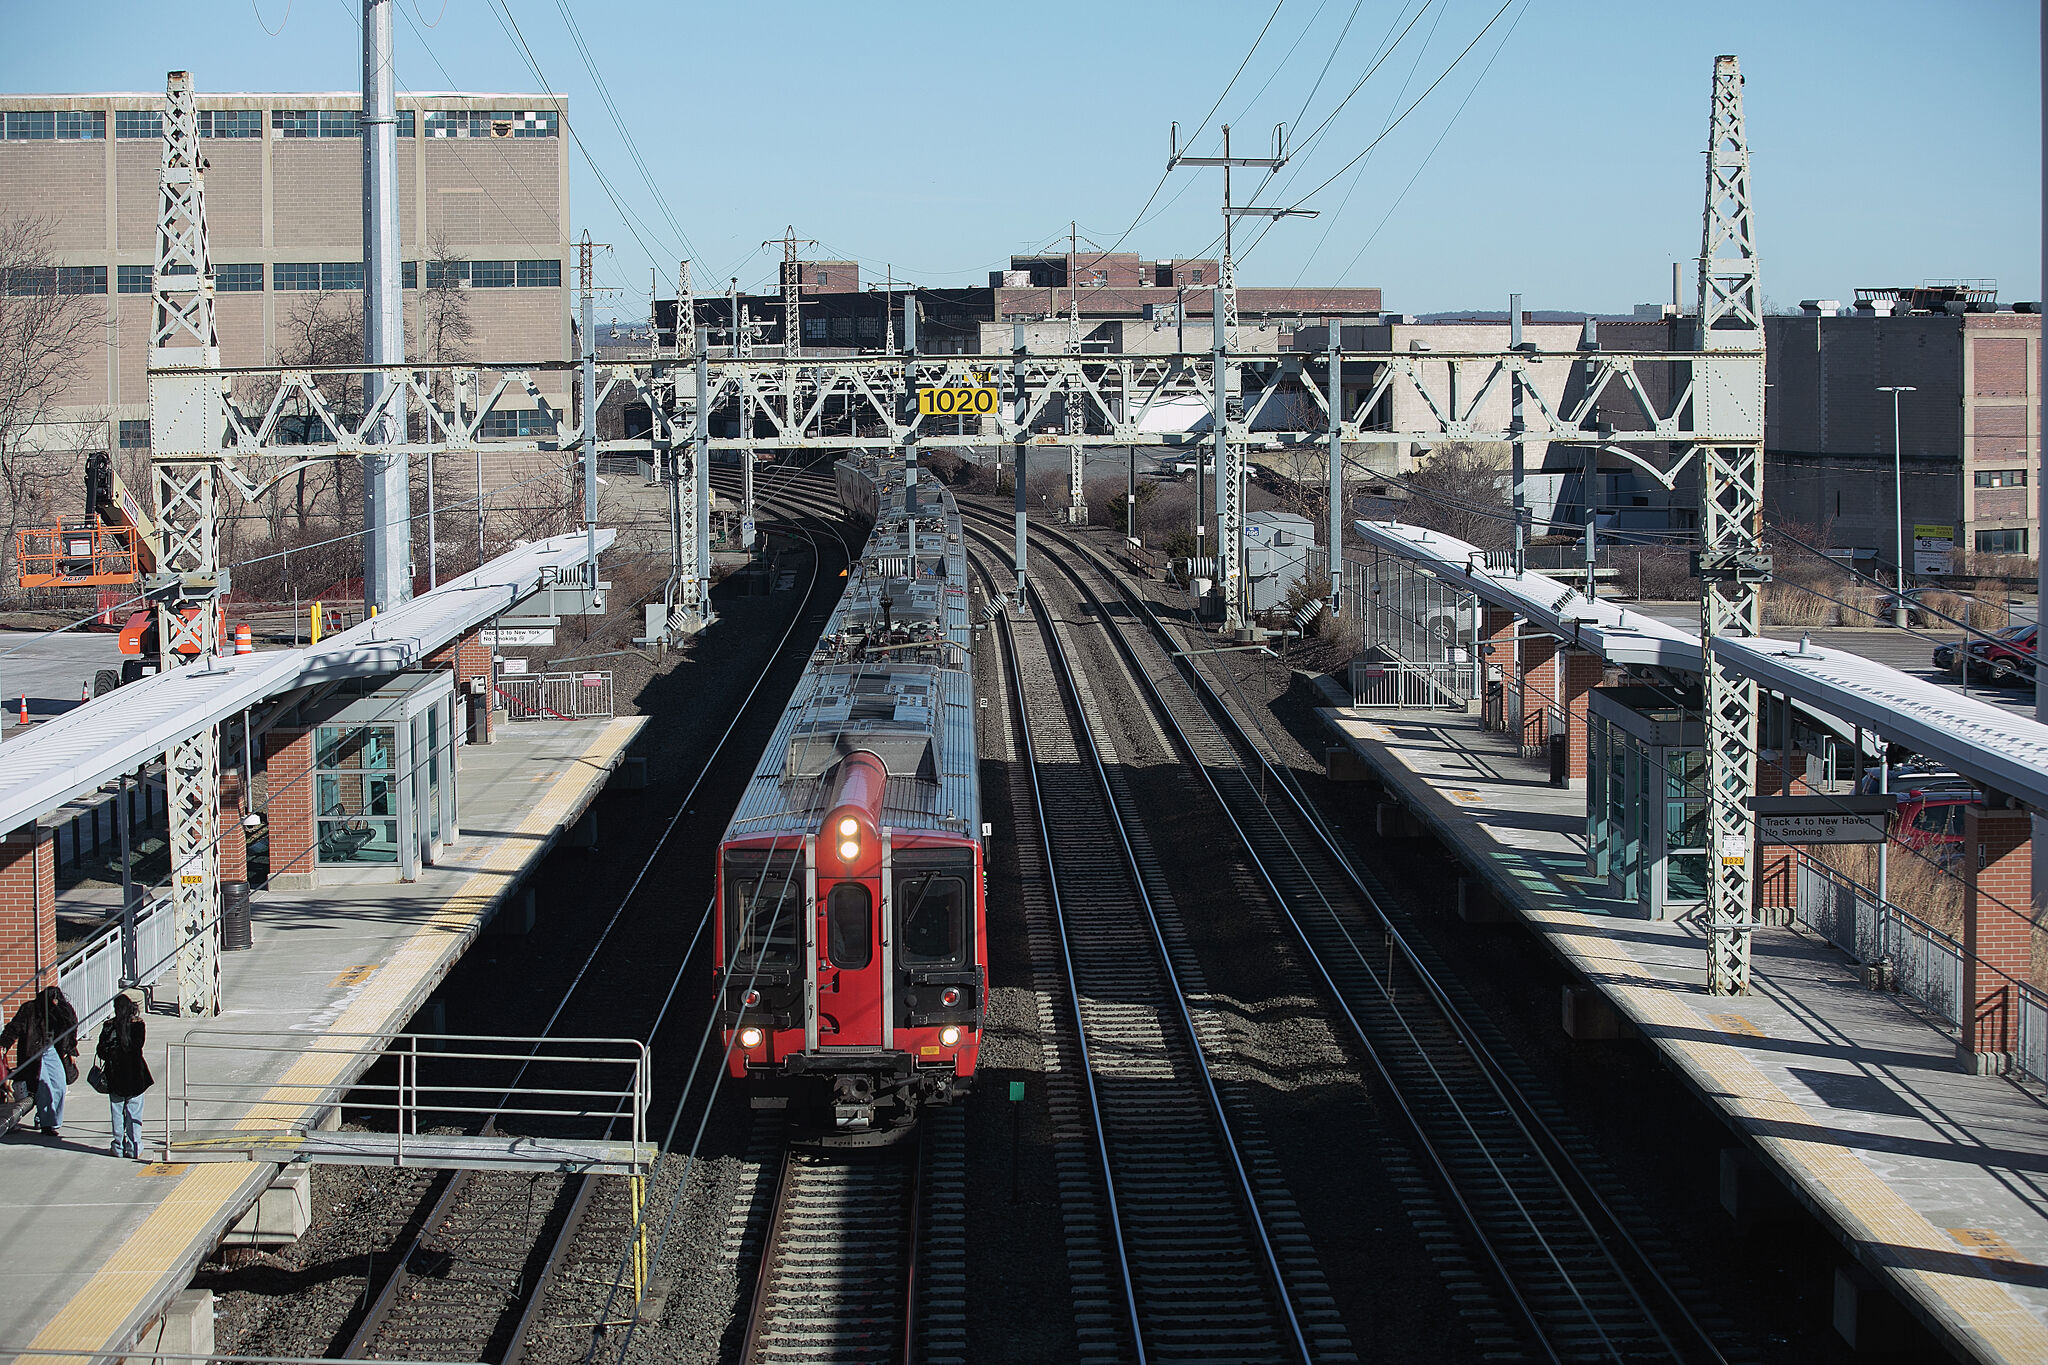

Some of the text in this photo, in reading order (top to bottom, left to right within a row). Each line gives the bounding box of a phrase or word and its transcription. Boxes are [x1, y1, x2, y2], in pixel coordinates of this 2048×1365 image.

[923, 389, 993, 413] 1020
[1765, 818, 1791, 827] Track
[1794, 817, 1801, 826] 4
[1805, 817, 1815, 826] to
[1818, 816, 1838, 826] New
[1782, 827, 1822, 837] Smoking
[1724, 857, 1744, 865] 1020
[182, 876, 202, 884] 1020
